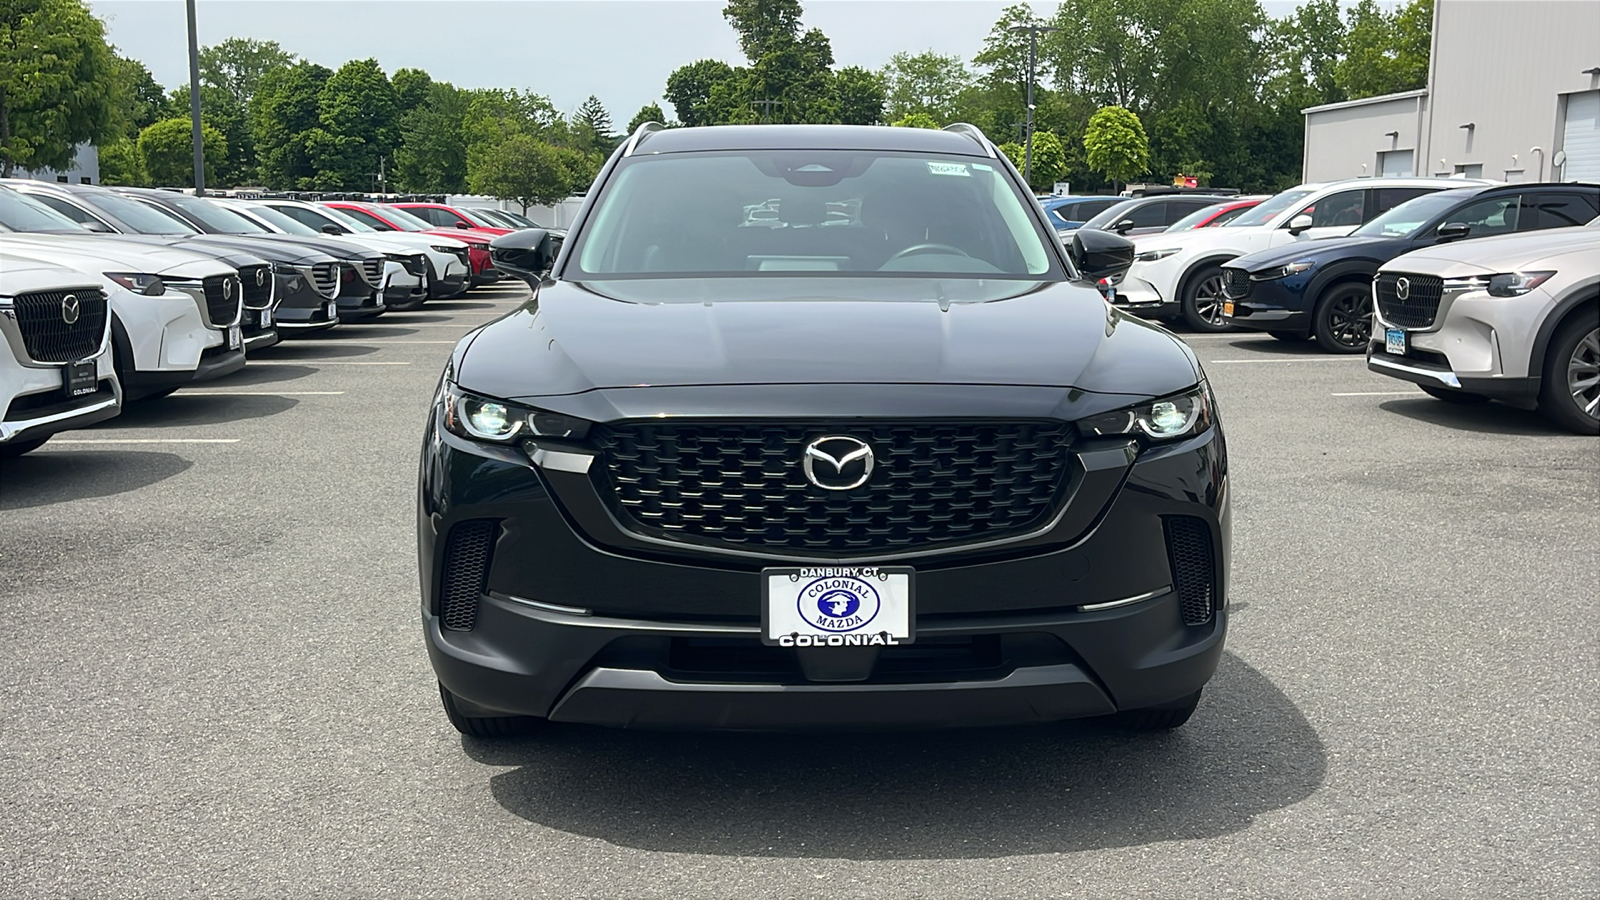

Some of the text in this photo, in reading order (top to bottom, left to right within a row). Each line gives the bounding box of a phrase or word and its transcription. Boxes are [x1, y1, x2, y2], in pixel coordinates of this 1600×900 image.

[800, 567, 879, 578] DANBURY, CT
[808, 580, 869, 599] COLONIAL
[816, 615, 863, 629] MAZDA
[779, 634, 899, 647] COLONIAL
